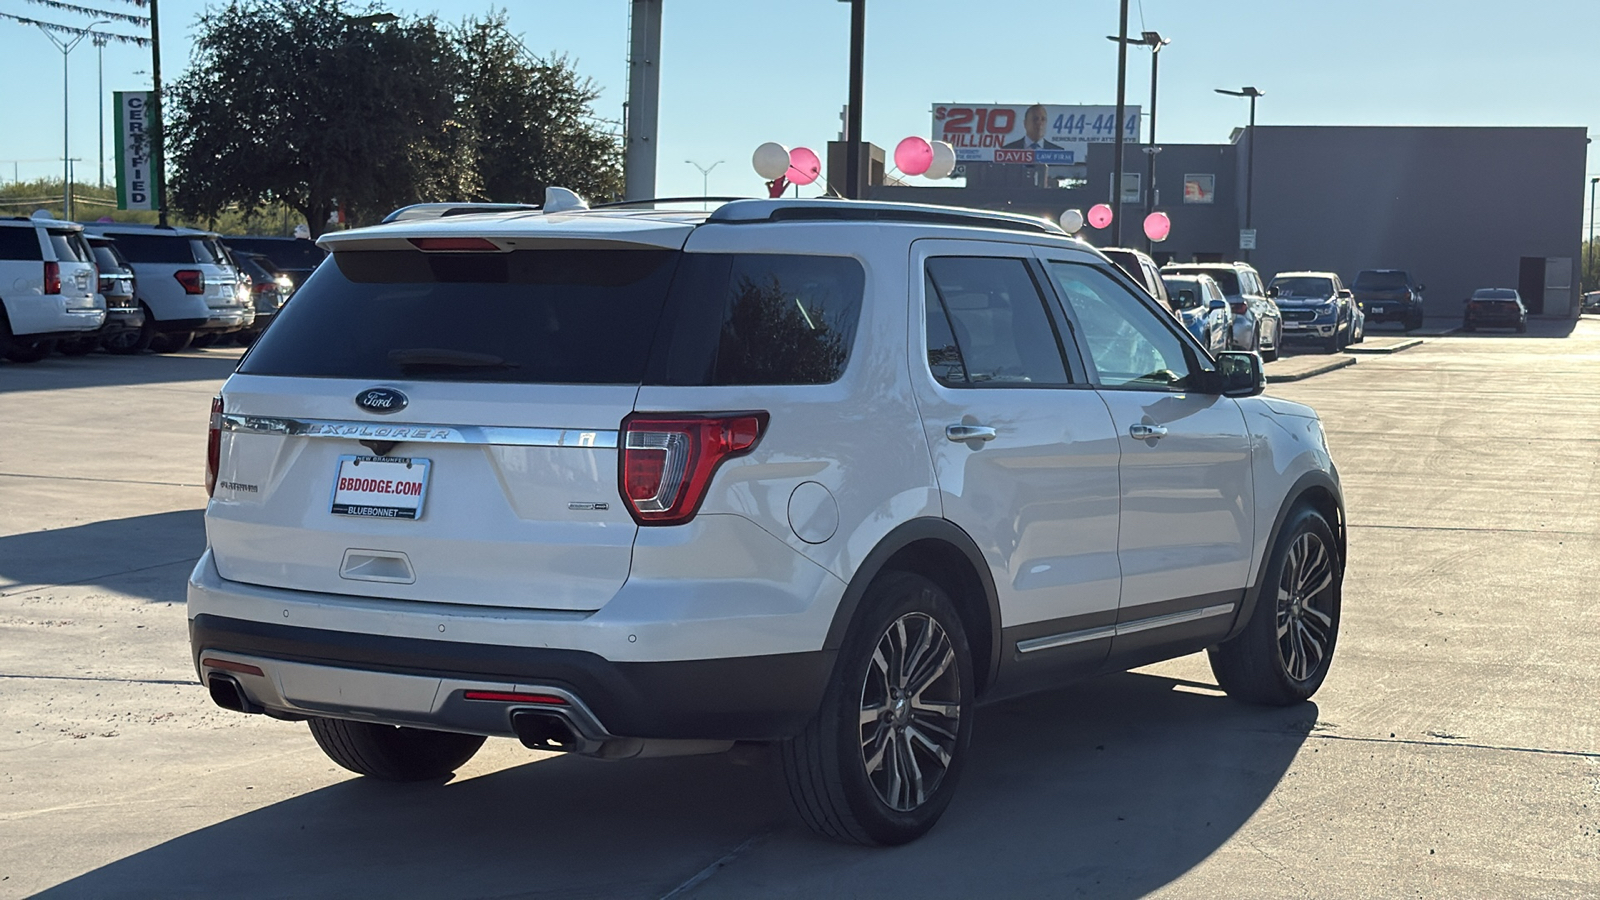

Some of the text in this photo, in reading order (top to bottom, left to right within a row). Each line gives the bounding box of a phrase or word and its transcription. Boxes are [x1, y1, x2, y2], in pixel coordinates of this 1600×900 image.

[935, 105, 1015, 134] $210
[1053, 113, 1137, 135] 444-444
[942, 133, 1006, 148] MILLION
[127, 97, 146, 203] CERTIFIED
[996, 151, 1072, 162] DAVIS LAW FIRM
[363, 391, 394, 408] Ford
[306, 424, 451, 440] EXPLORER
[340, 477, 423, 496] BBDODGE.COM
[347, 506, 399, 517] BLUEBONNET
